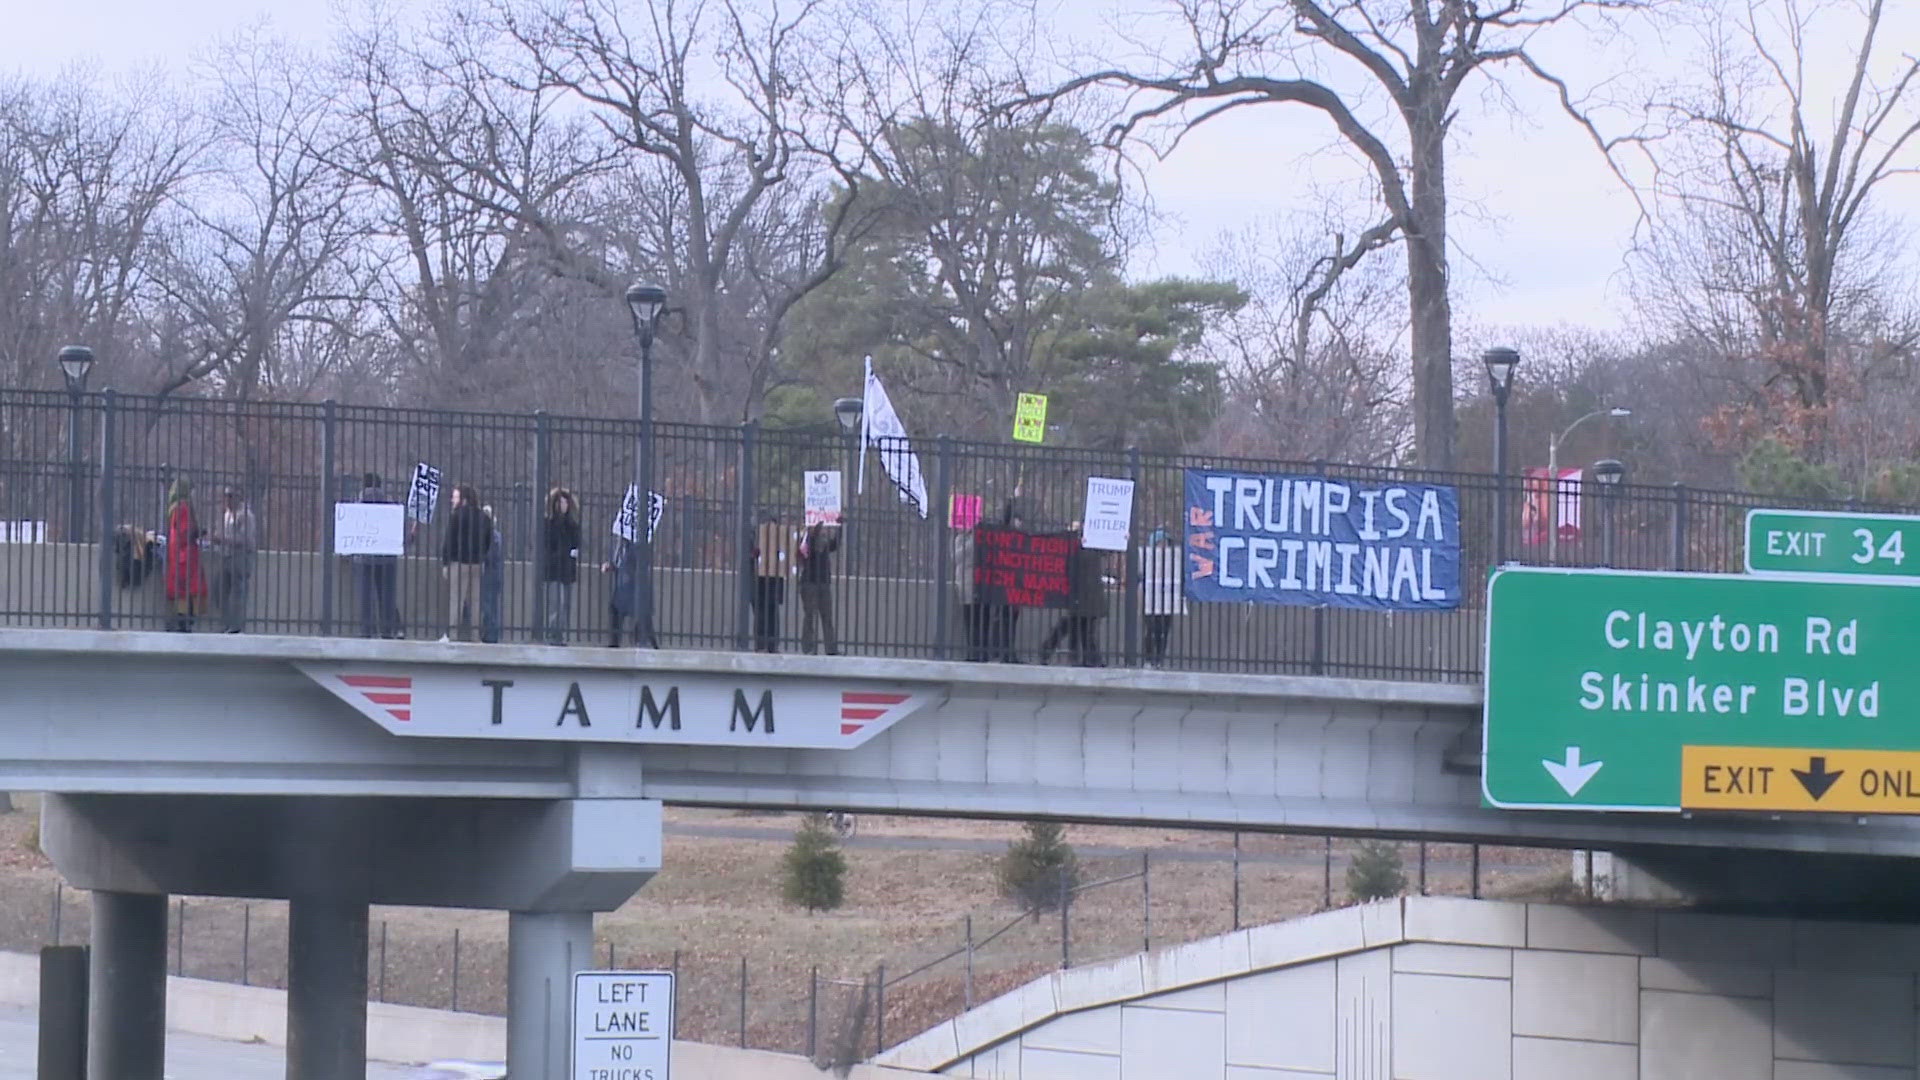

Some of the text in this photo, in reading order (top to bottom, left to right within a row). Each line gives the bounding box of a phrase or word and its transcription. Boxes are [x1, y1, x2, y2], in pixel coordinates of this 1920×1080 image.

[814, 473, 829, 484] NO
[1091, 483, 1131, 496] TRUMP
[1207, 477, 1443, 540] TRUMP IS A
[1089, 519, 1127, 531] HITLER
[1031, 536, 1079, 553] FIGHT
[1189, 507, 1215, 580] WAR
[1767, 528, 1905, 565] EXIT 34
[986, 550, 1066, 573] ANOTHER
[1219, 537, 1446, 601] CRIMINAL
[1007, 588, 1045, 607] WAR
[1605, 610, 1857, 660] Clayton Rd
[1580, 671, 1879, 717] Skinker Blvd
[482, 680, 775, 733] TAMM
[1704, 765, 1774, 794] EXIT
[598, 983, 648, 1003] LEFT
[595, 1012, 649, 1032] LANE
[611, 1045, 632, 1060] NO
[590, 1068, 654, 1080] TRUCKS
